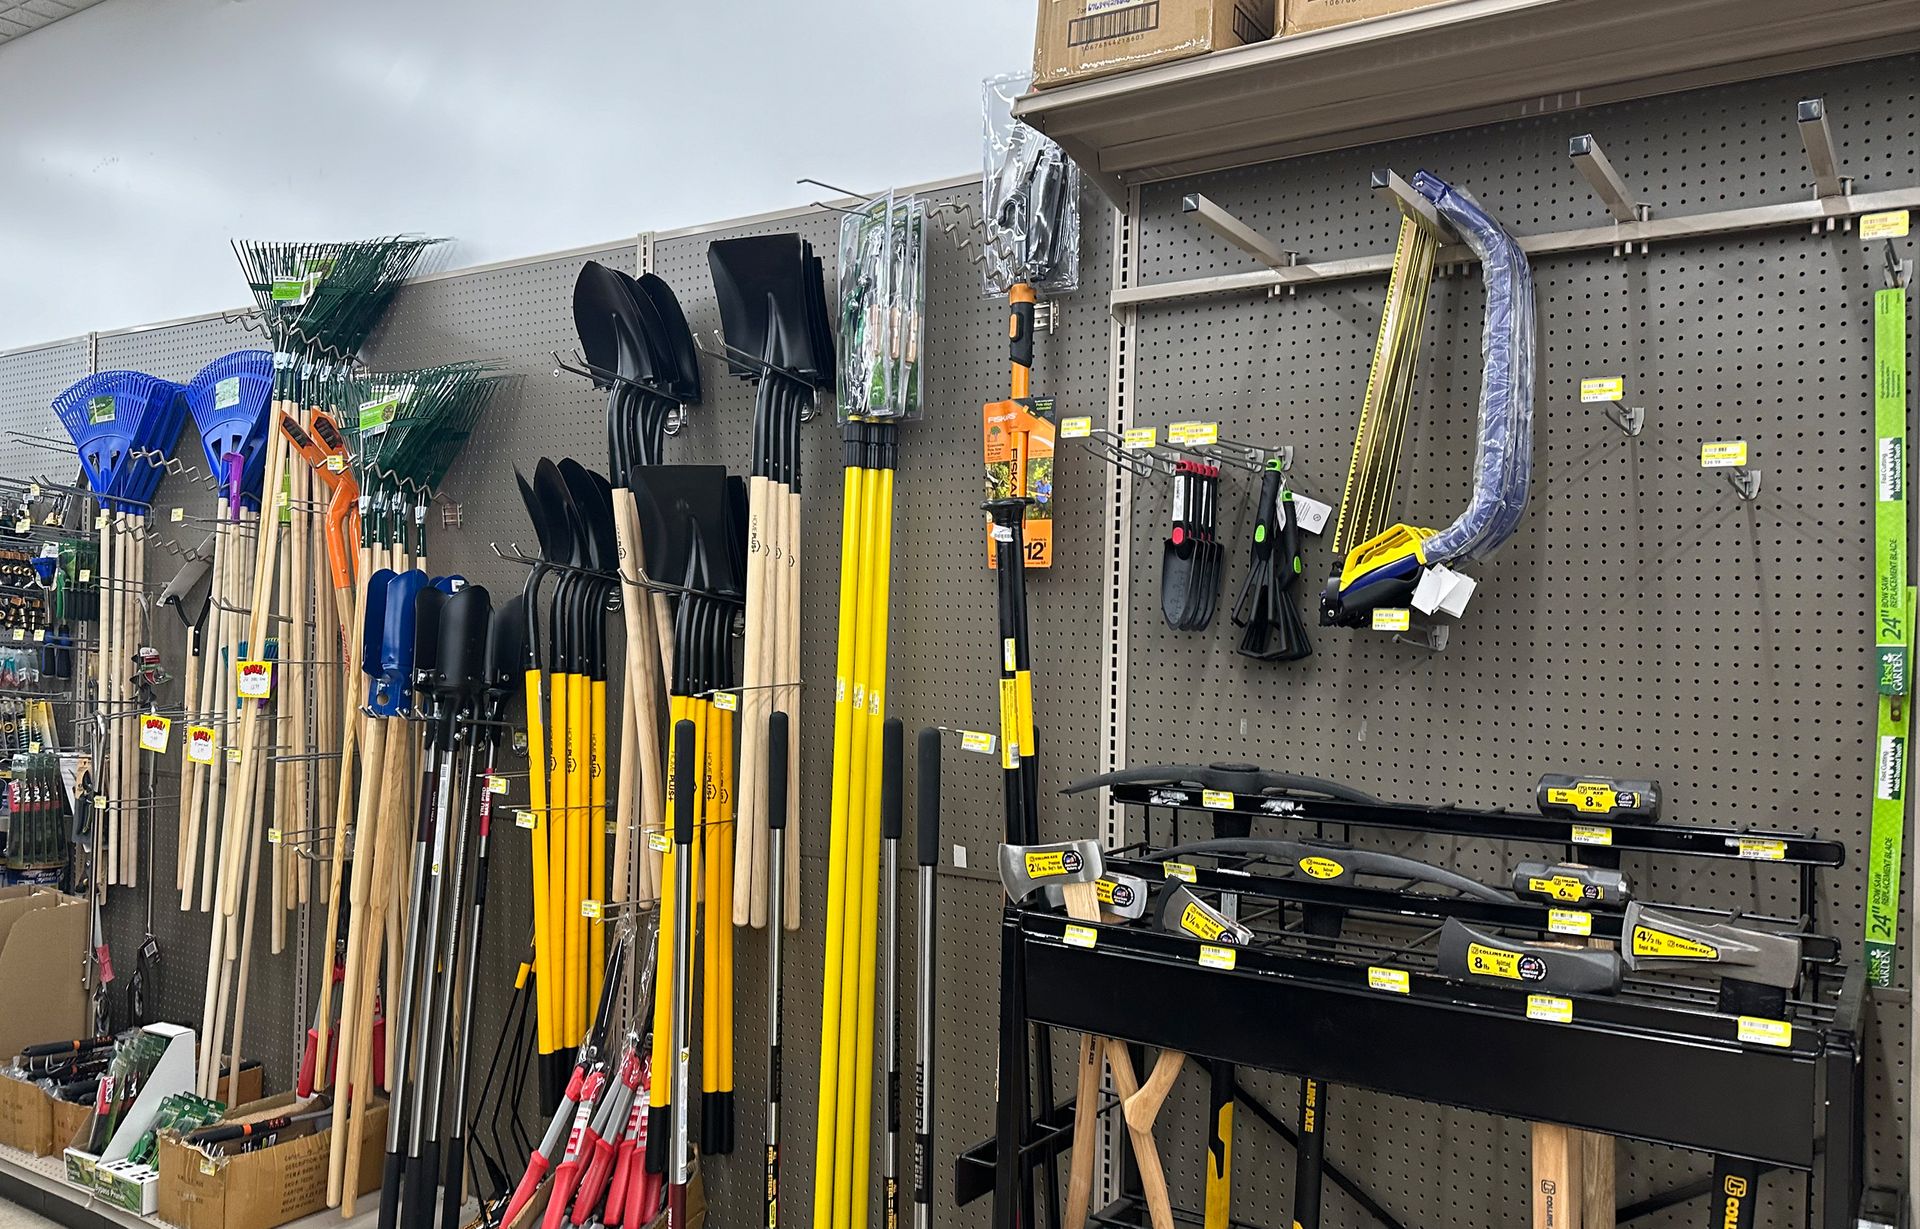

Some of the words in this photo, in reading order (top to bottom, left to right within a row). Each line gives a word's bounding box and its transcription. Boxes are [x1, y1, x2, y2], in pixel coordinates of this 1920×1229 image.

[1890, 539, 1898, 560] BLADE
[1890, 561, 1898, 608] REPLACEMENT
[1881, 609, 1902, 641] 24"
[1892, 652, 1903, 691] GARDEN
[1586, 796, 1594, 806] 8
[1559, 888, 1566, 896] 6
[1872, 905, 1892, 938] 24"
[1479, 949, 1501, 957] COLLINS
[1675, 943, 1698, 952] COLLINS
[1475, 957, 1483, 969] 8
[915, 1063, 924, 1130] TRUPER
[1306, 1079, 1317, 1107] LINS
[1304, 1107, 1315, 1133] AXE
[1724, 1197, 1740, 1229] COLL
